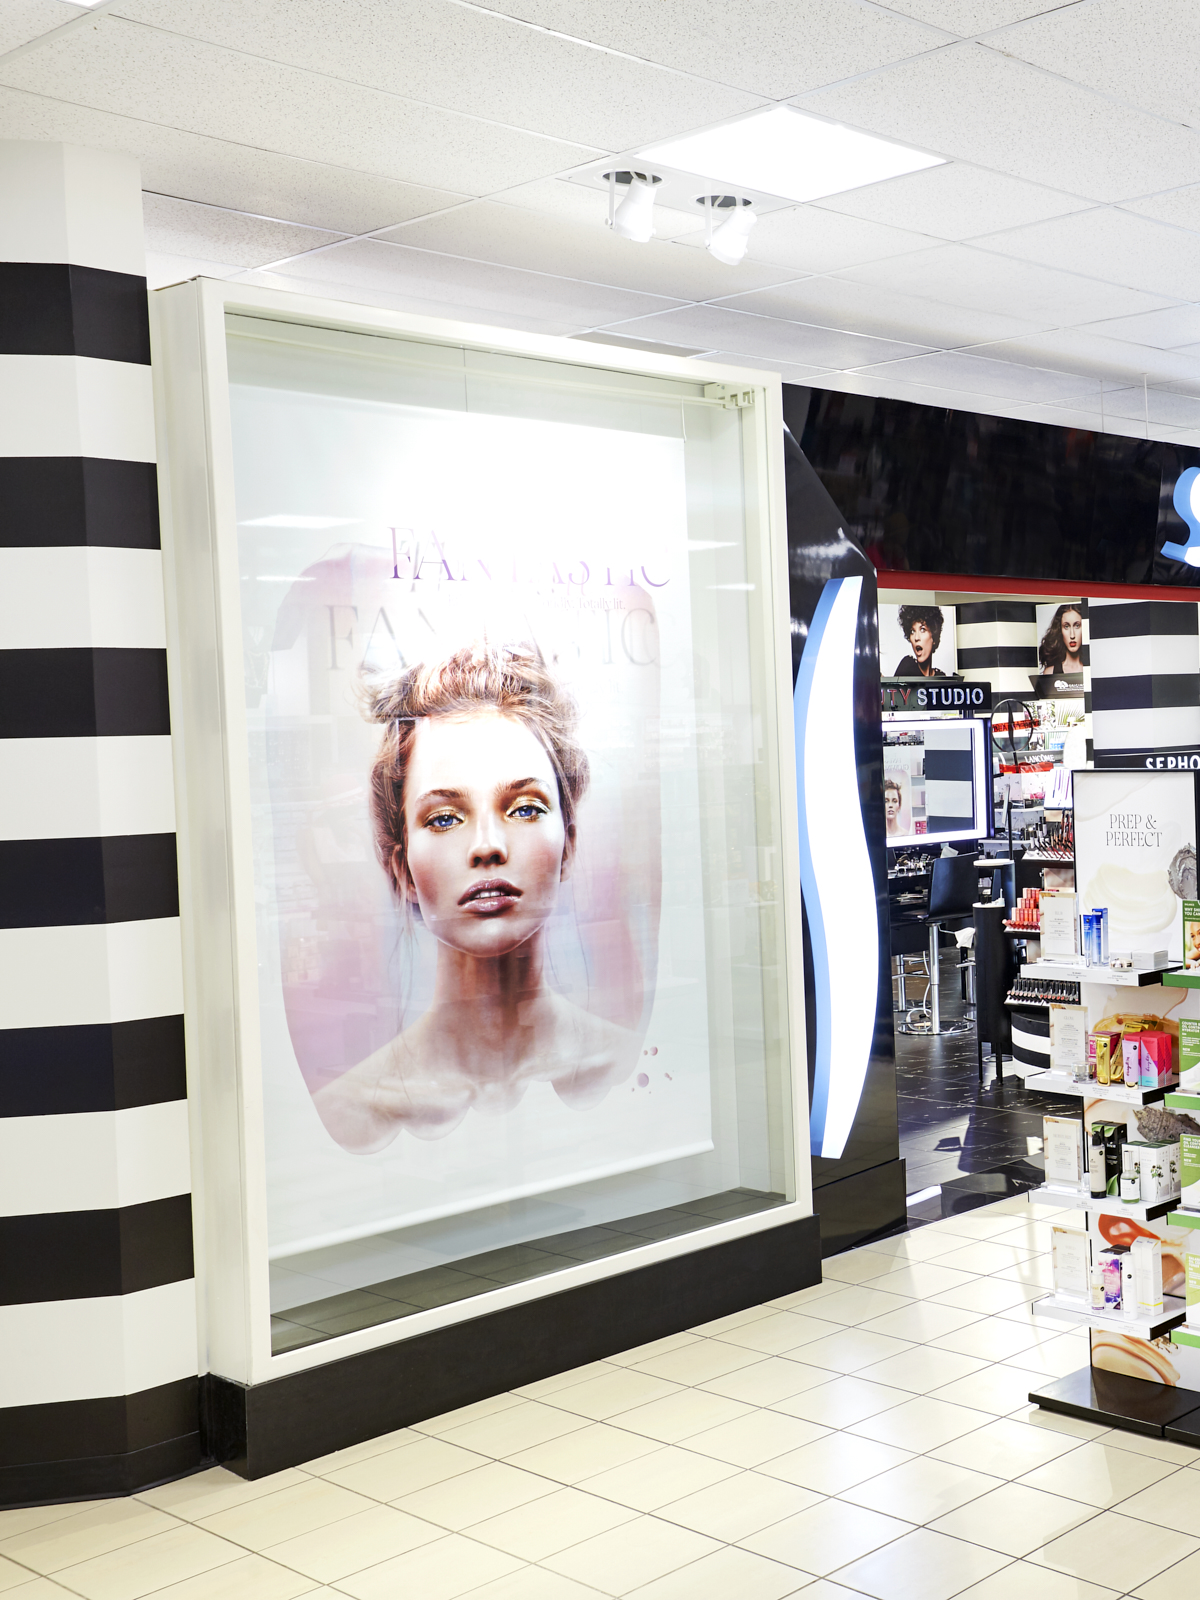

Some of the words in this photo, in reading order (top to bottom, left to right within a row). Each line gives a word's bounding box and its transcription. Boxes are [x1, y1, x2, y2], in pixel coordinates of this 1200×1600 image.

[917, 688, 984, 706] STUDIO
[1109, 814, 1142, 830] PREP
[1145, 814, 1157, 830] &
[1105, 832, 1162, 848] PERFECT
